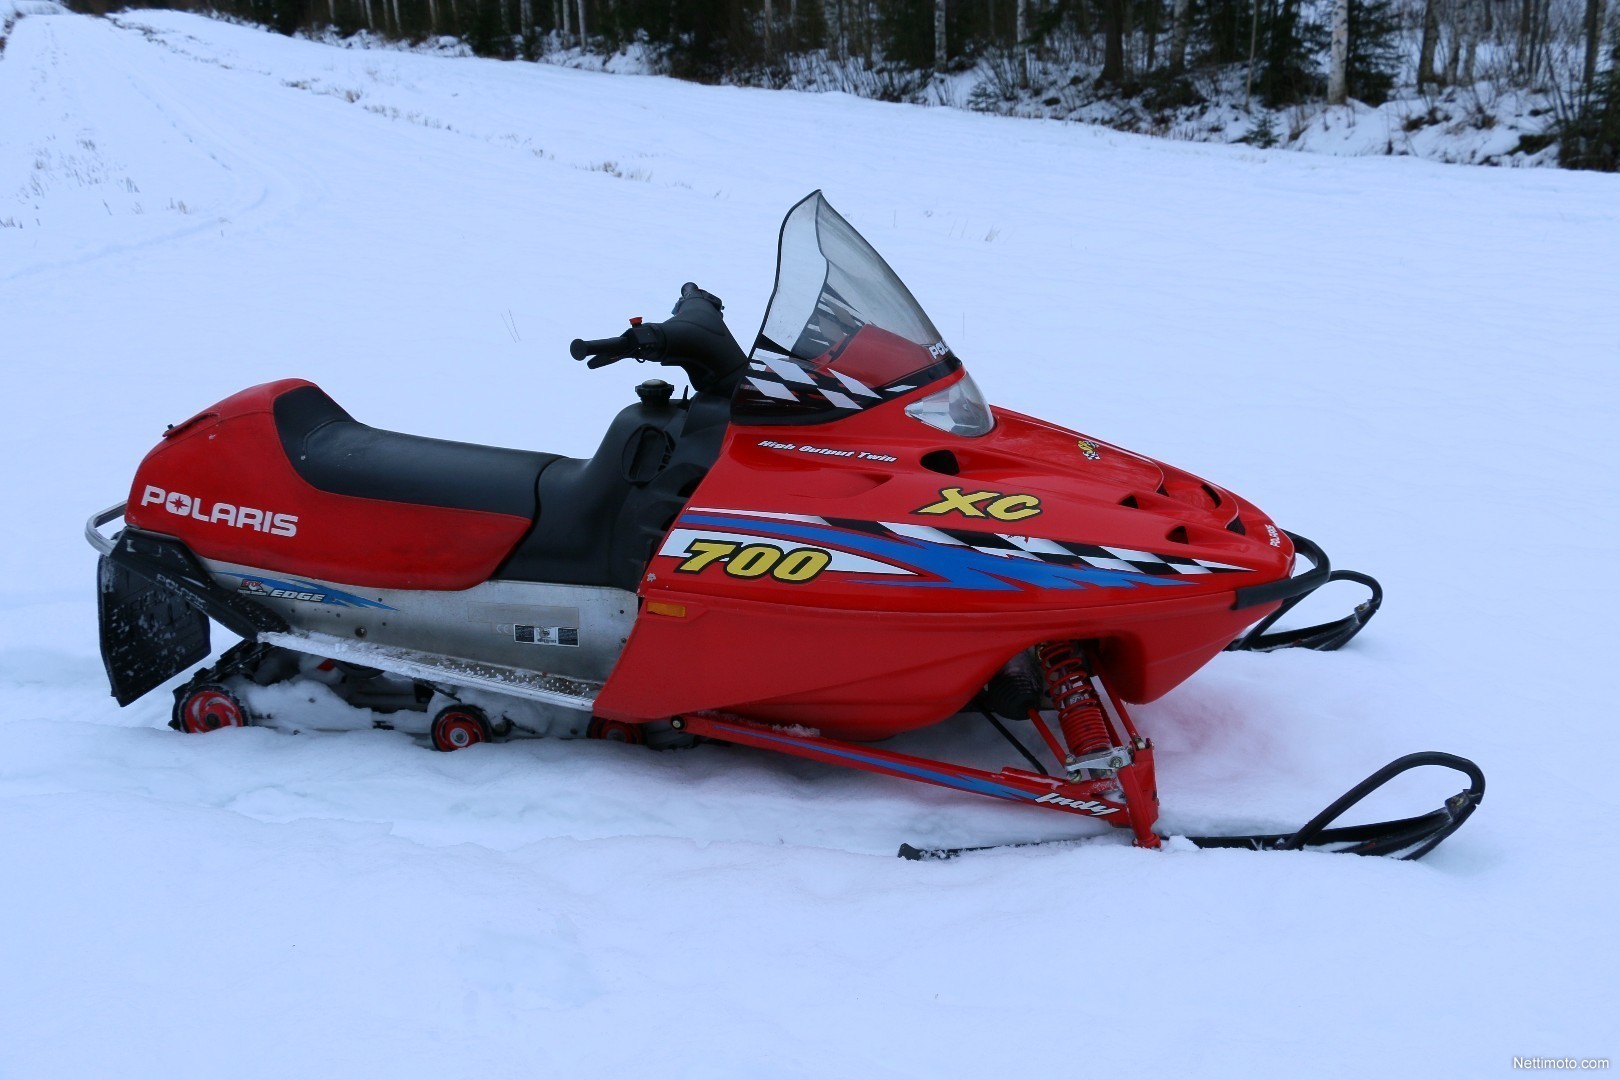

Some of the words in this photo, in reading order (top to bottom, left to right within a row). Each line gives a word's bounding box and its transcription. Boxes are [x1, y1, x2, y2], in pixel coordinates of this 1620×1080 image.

[757, 440, 796, 450] High
[799, 445, 855, 457] Output
[857, 451, 898, 462] Twin
[141, 485, 299, 537] POLARIS
[909, 486, 1043, 521] XC
[675, 538, 832, 584] 700
[270, 589, 326, 602] EDGE
[1034, 792, 1121, 816] Indy
